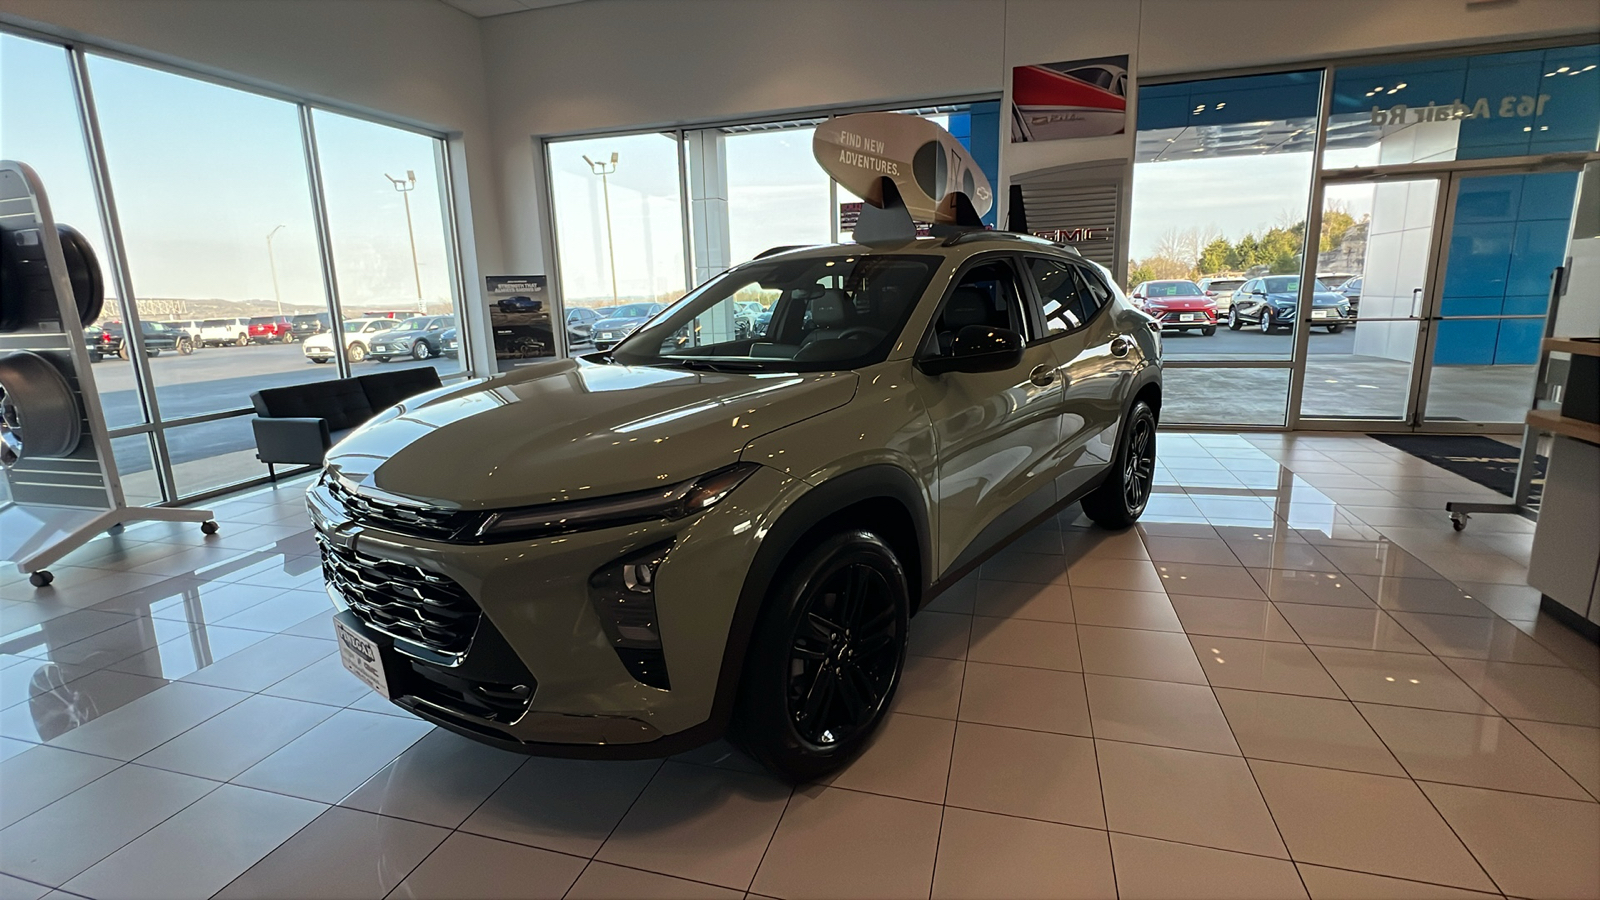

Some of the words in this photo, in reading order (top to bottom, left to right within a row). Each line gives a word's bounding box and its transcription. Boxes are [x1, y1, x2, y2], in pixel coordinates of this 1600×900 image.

[840, 130, 862, 148] FIND
[864, 137, 885, 154] NEW
[839, 149, 900, 176] ADVENTURES.
